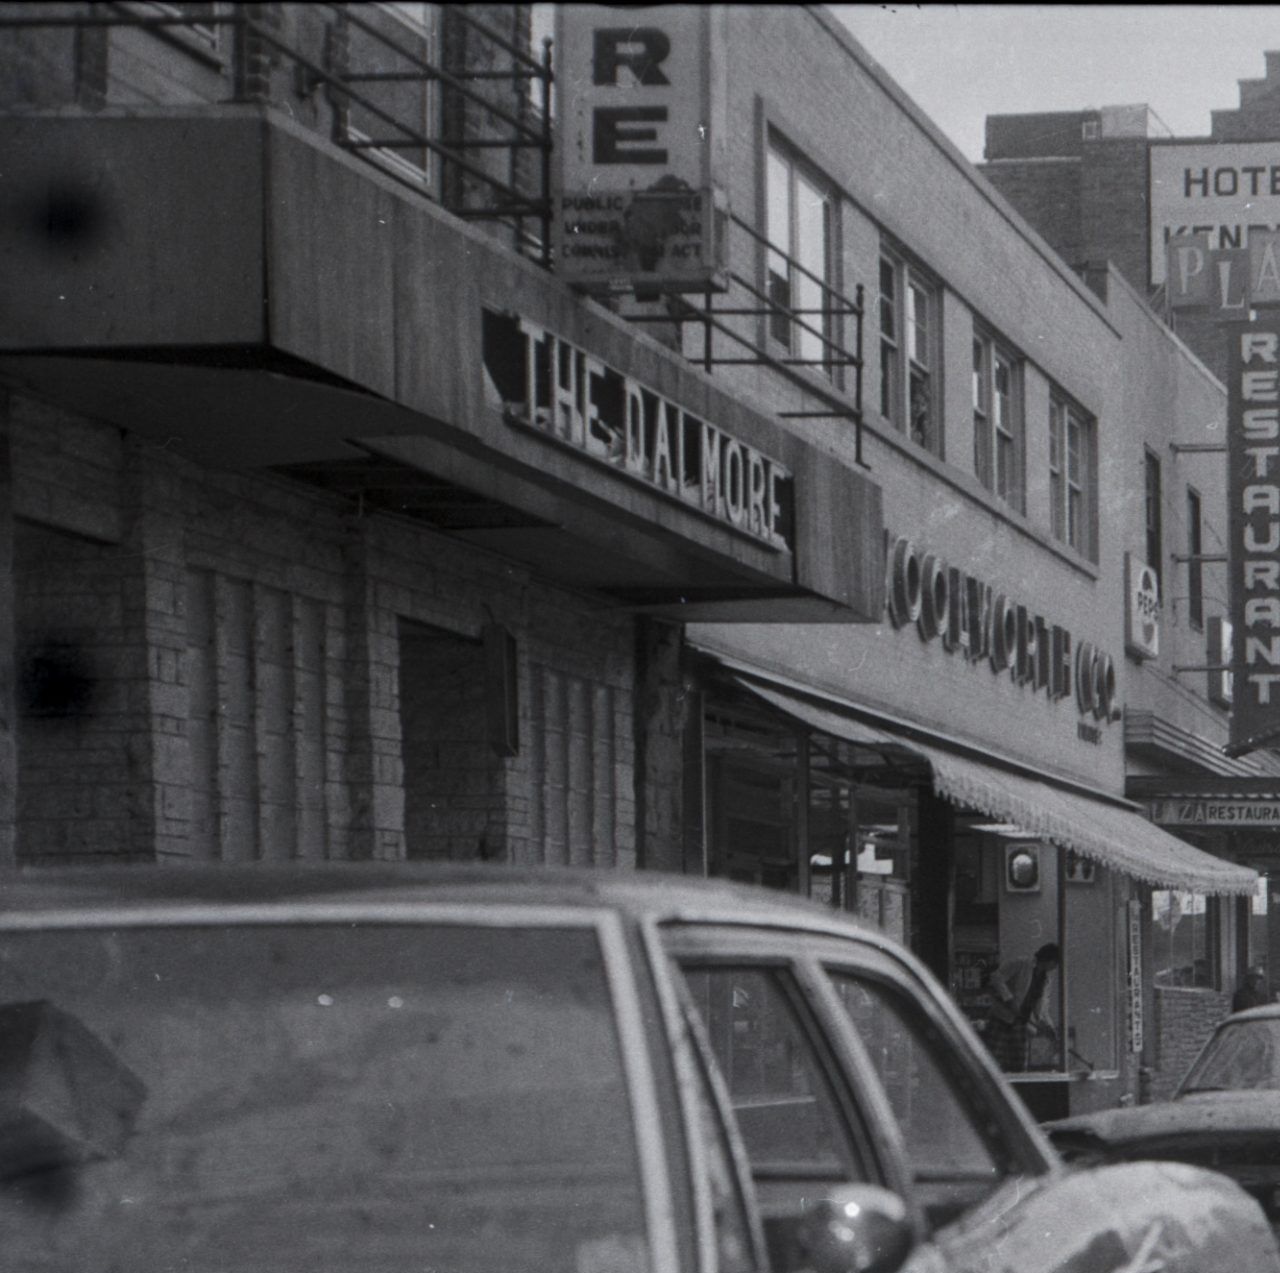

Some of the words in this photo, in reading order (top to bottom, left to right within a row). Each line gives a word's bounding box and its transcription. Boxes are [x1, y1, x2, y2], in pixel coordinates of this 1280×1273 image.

[520, 318, 610, 456] THE
[625, 376, 793, 551] DALMORE
[885, 534, 1071, 704] OOLWORTH
[1152, 802, 1205, 823] LAZA
